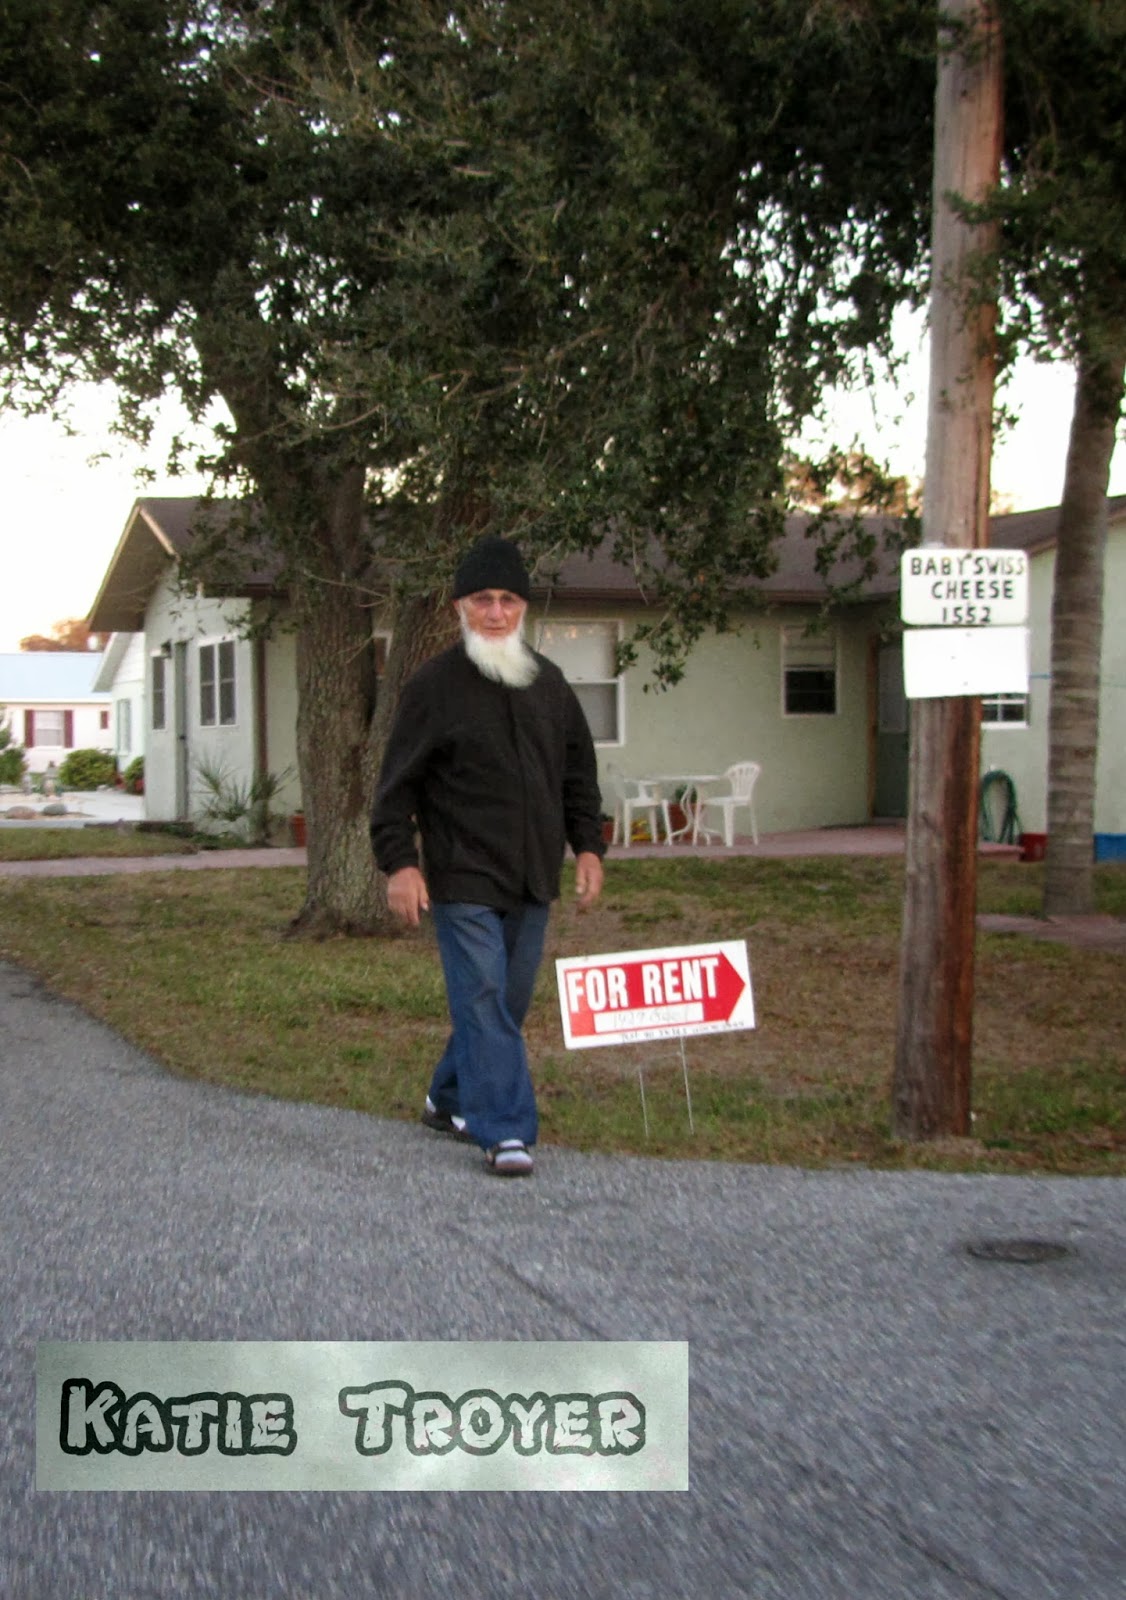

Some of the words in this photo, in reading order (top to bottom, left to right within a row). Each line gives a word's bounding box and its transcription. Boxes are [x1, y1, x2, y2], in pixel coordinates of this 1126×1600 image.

[910, 556, 966, 576] BABY
[973, 556, 1024, 576] SWISS
[931, 580, 1014, 600] CHEESE
[942, 606, 992, 624] 1552
[565, 966, 629, 1014] FOR
[641, 956, 719, 1006] RENT
